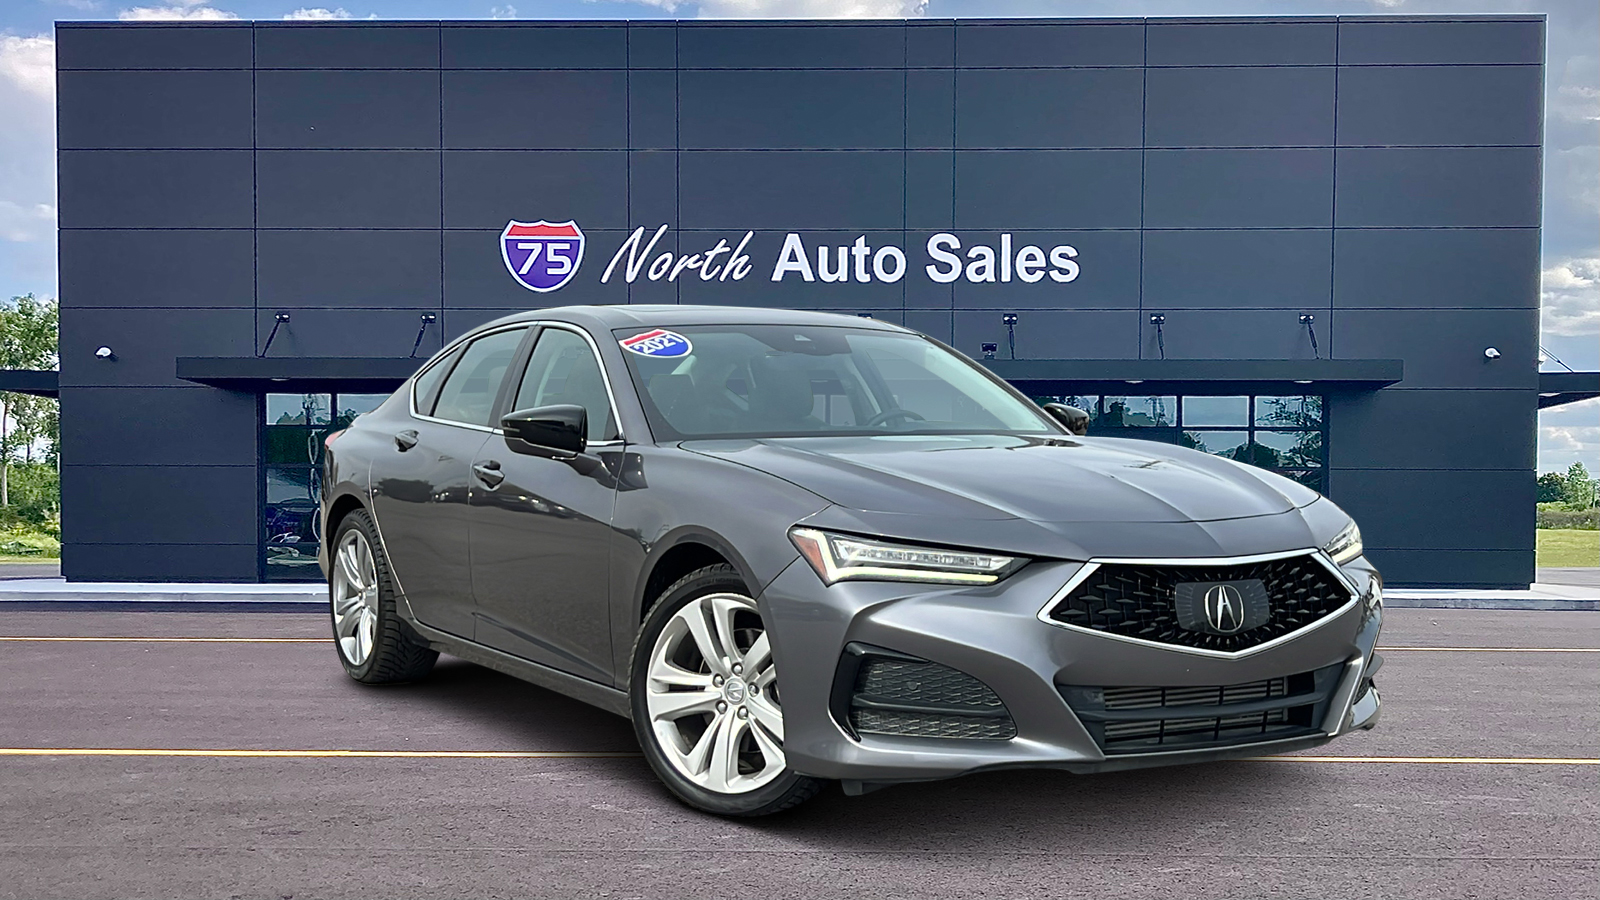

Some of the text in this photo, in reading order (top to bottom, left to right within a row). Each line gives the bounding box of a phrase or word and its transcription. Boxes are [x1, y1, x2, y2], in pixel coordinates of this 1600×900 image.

[517, 224, 1080, 284] 75 North Auto Sales
[634, 333, 684, 355] 2021
